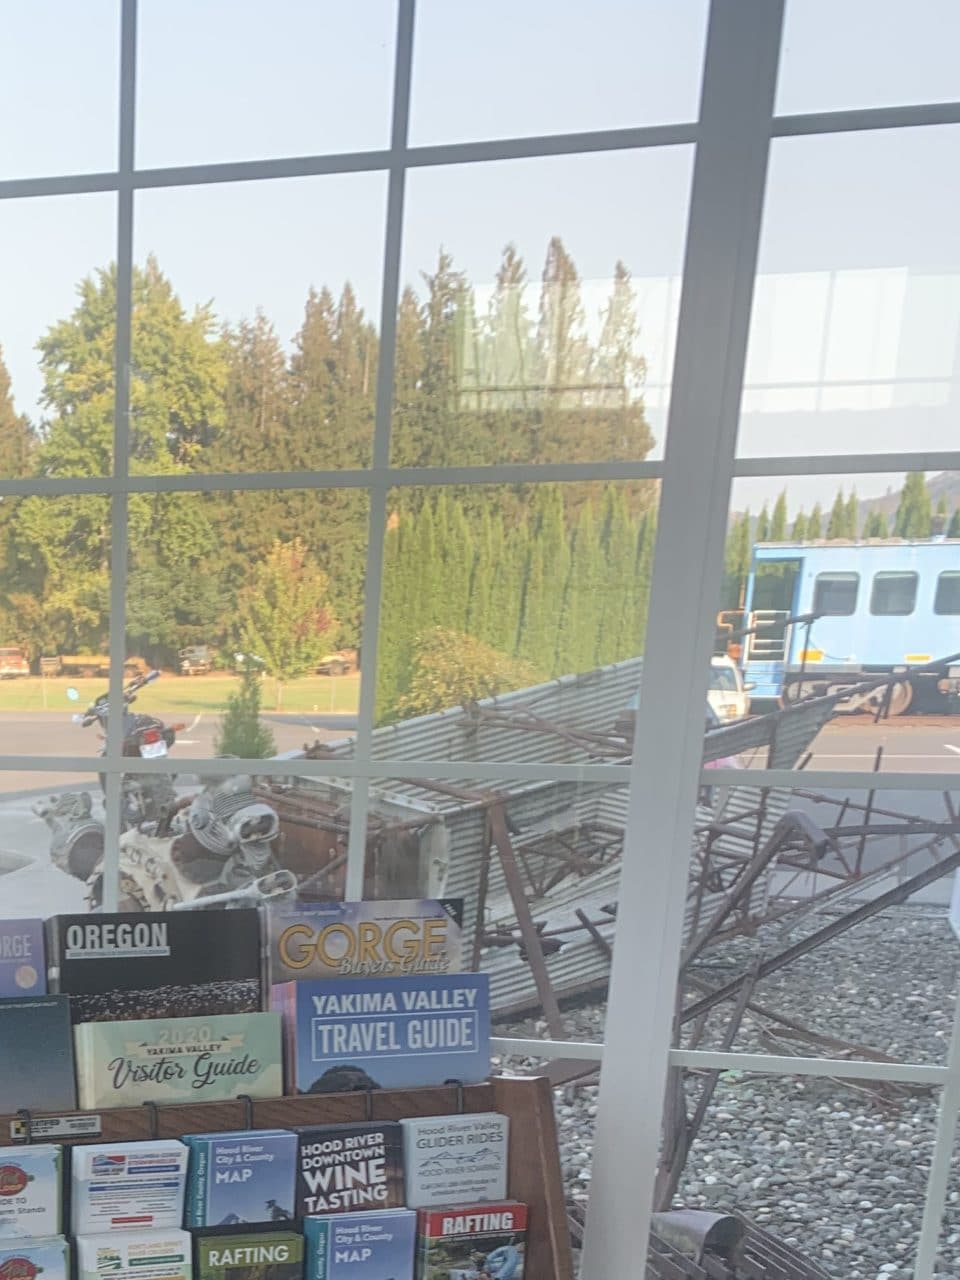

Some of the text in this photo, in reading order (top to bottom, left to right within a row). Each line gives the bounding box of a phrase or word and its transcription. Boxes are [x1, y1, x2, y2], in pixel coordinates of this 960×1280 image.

[67, 923, 168, 950] OREGON
[278, 918, 449, 969] GORGE
[311, 988, 478, 1015] YAKIMA VALLEY
[158, 1023, 211, 1044] 2020
[318, 1016, 474, 1055] TRAVEL GUIDE
[146, 1043, 222, 1057] YAKIMA VALLEY
[107, 1051, 260, 1090] Visitor Guide
[417, 1131, 503, 1149] GLIDER RIDES
[418, 1122, 501, 1136] Hood River Valley
[301, 1133, 385, 1157] HOOD RIVER
[302, 1146, 385, 1169] DOWNTOWN
[215, 1169, 253, 1184] MAP
[303, 1158, 387, 1194] WINE
[16, 1197, 27, 1205] TO
[304, 1185, 388, 1213] TASTING
[442, 1212, 513, 1235] RAFTING
[208, 1245, 289, 1267] RAFTING
[335, 1249, 372, 1264] MAP
